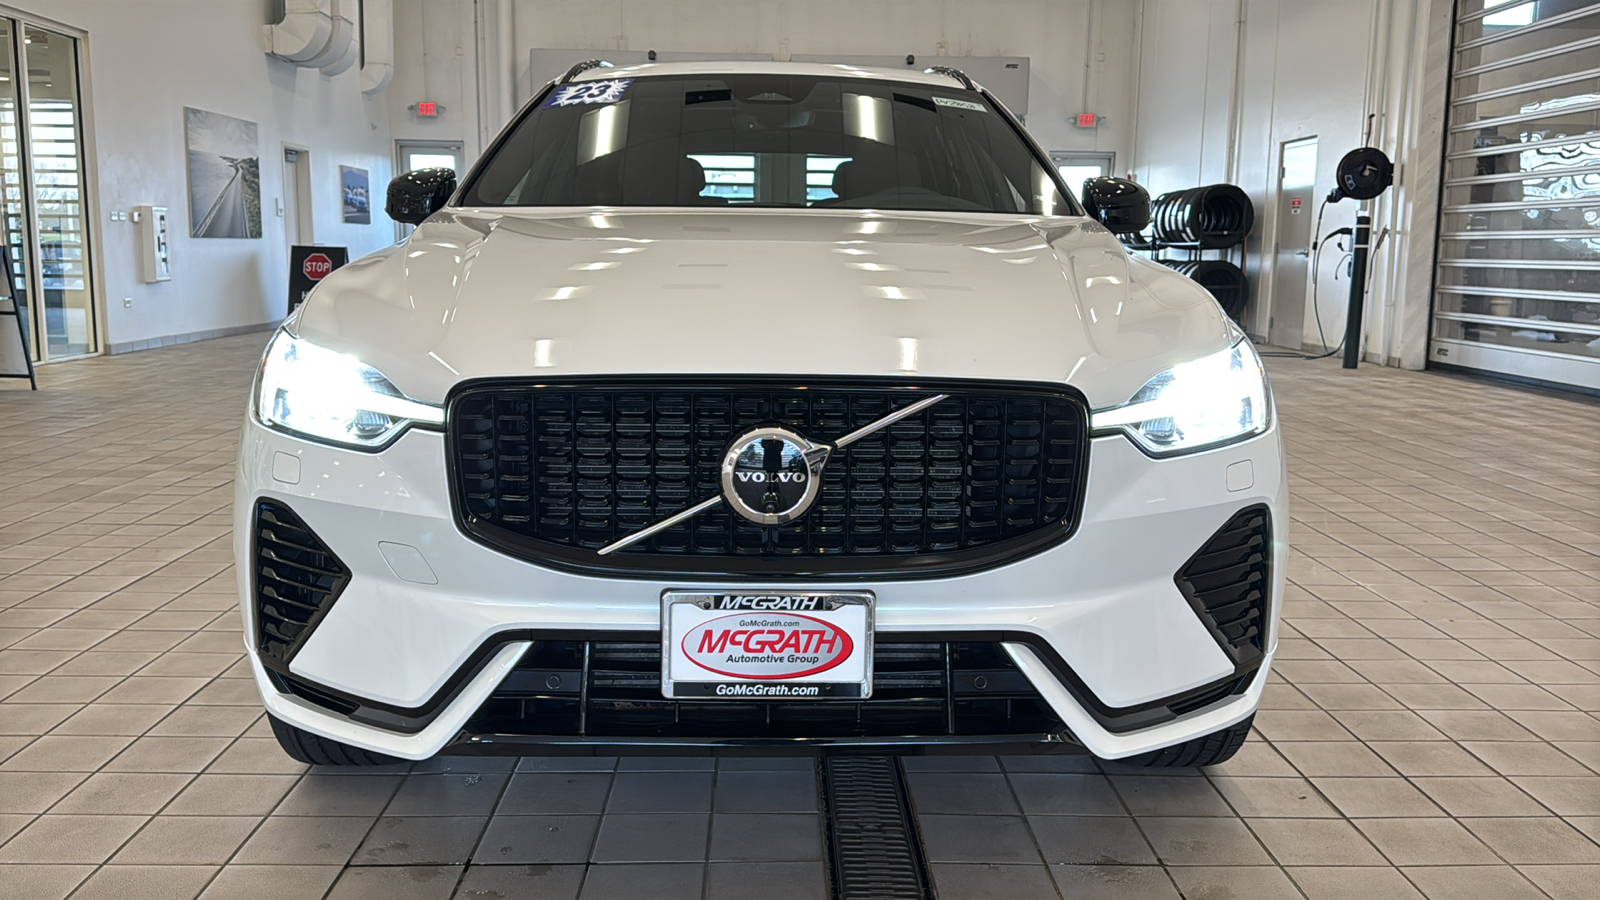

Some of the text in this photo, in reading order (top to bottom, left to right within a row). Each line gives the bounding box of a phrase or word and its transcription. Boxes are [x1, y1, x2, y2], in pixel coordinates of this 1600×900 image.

[565, 84, 612, 101] 23
[419, 102, 435, 115] EXIT
[1079, 113, 1094, 126] EXIT
[305, 262, 330, 272] STOP
[735, 471, 806, 483] VOLVO
[726, 654, 820, 665] Automotive Group
[716, 684, 819, 695] GoMcGrath.com
